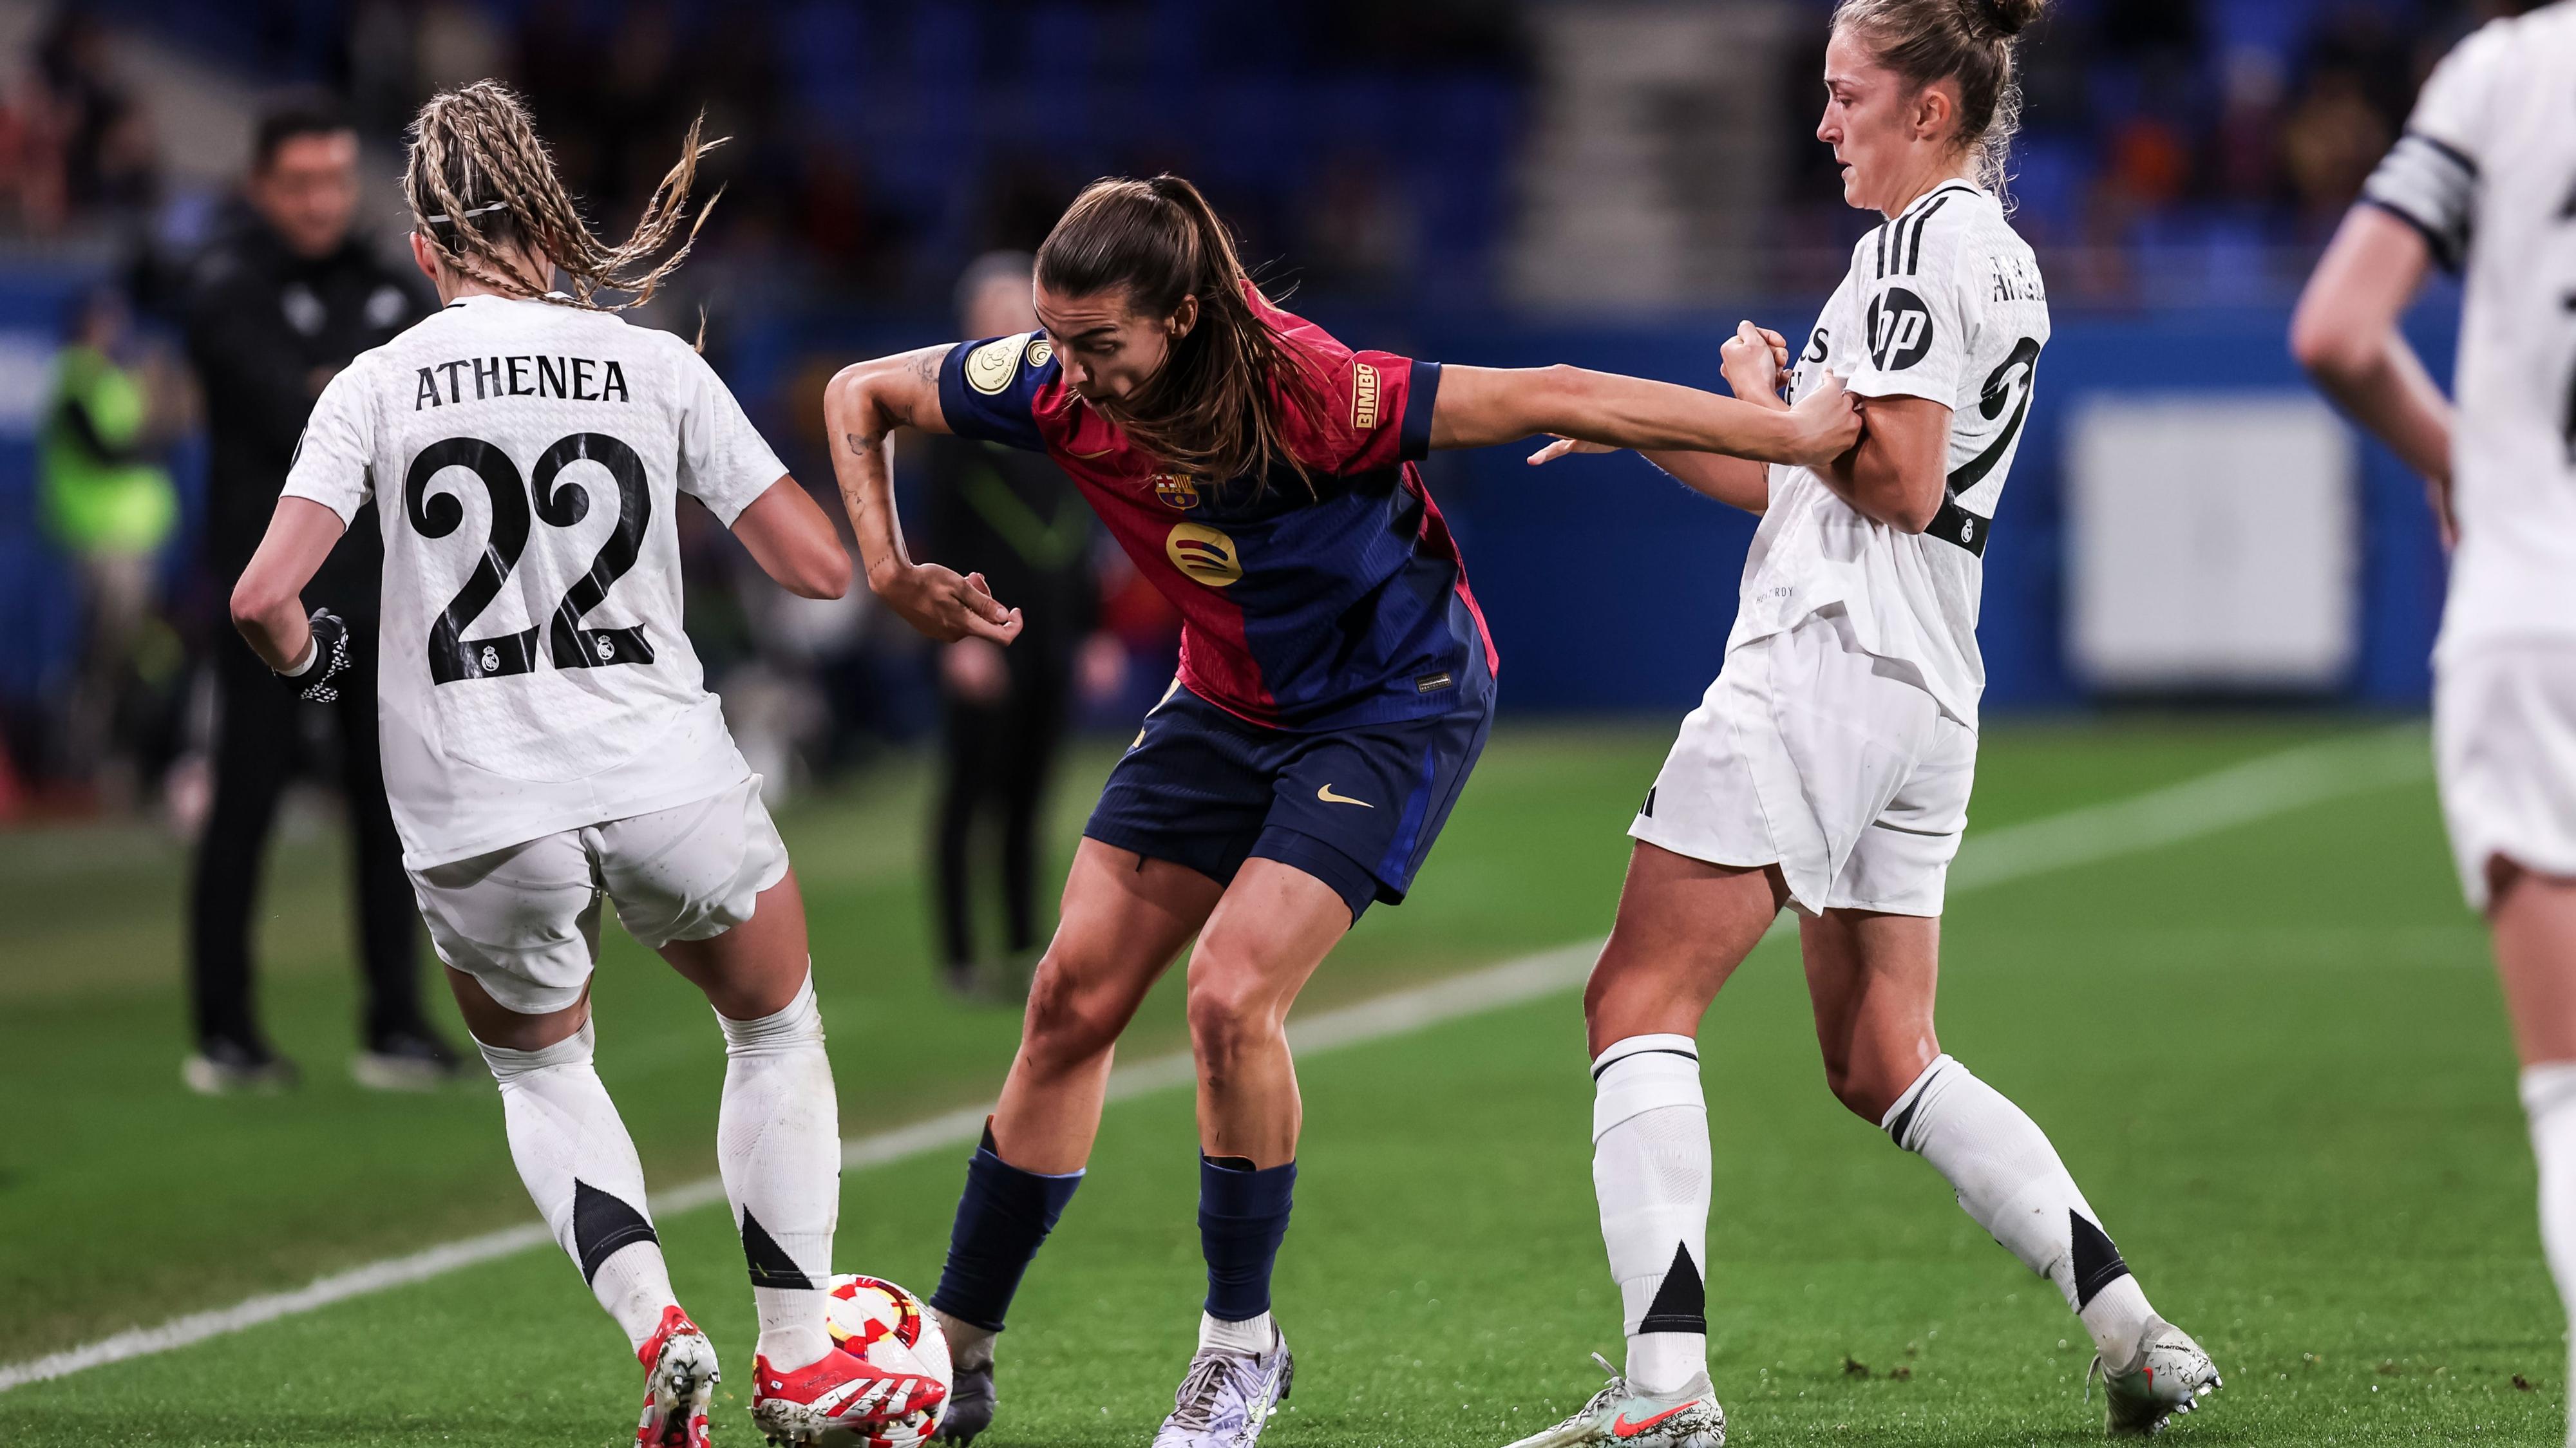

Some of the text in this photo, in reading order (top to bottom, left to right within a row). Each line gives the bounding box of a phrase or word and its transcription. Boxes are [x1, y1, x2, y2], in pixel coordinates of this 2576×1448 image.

[1869, 287, 1931, 371] hp
[415, 355, 630, 411] ATHENEA
[1356, 362, 1375, 428] BIMBO
[405, 432, 655, 686] 22
[1775, 587, 1794, 597] RDY
